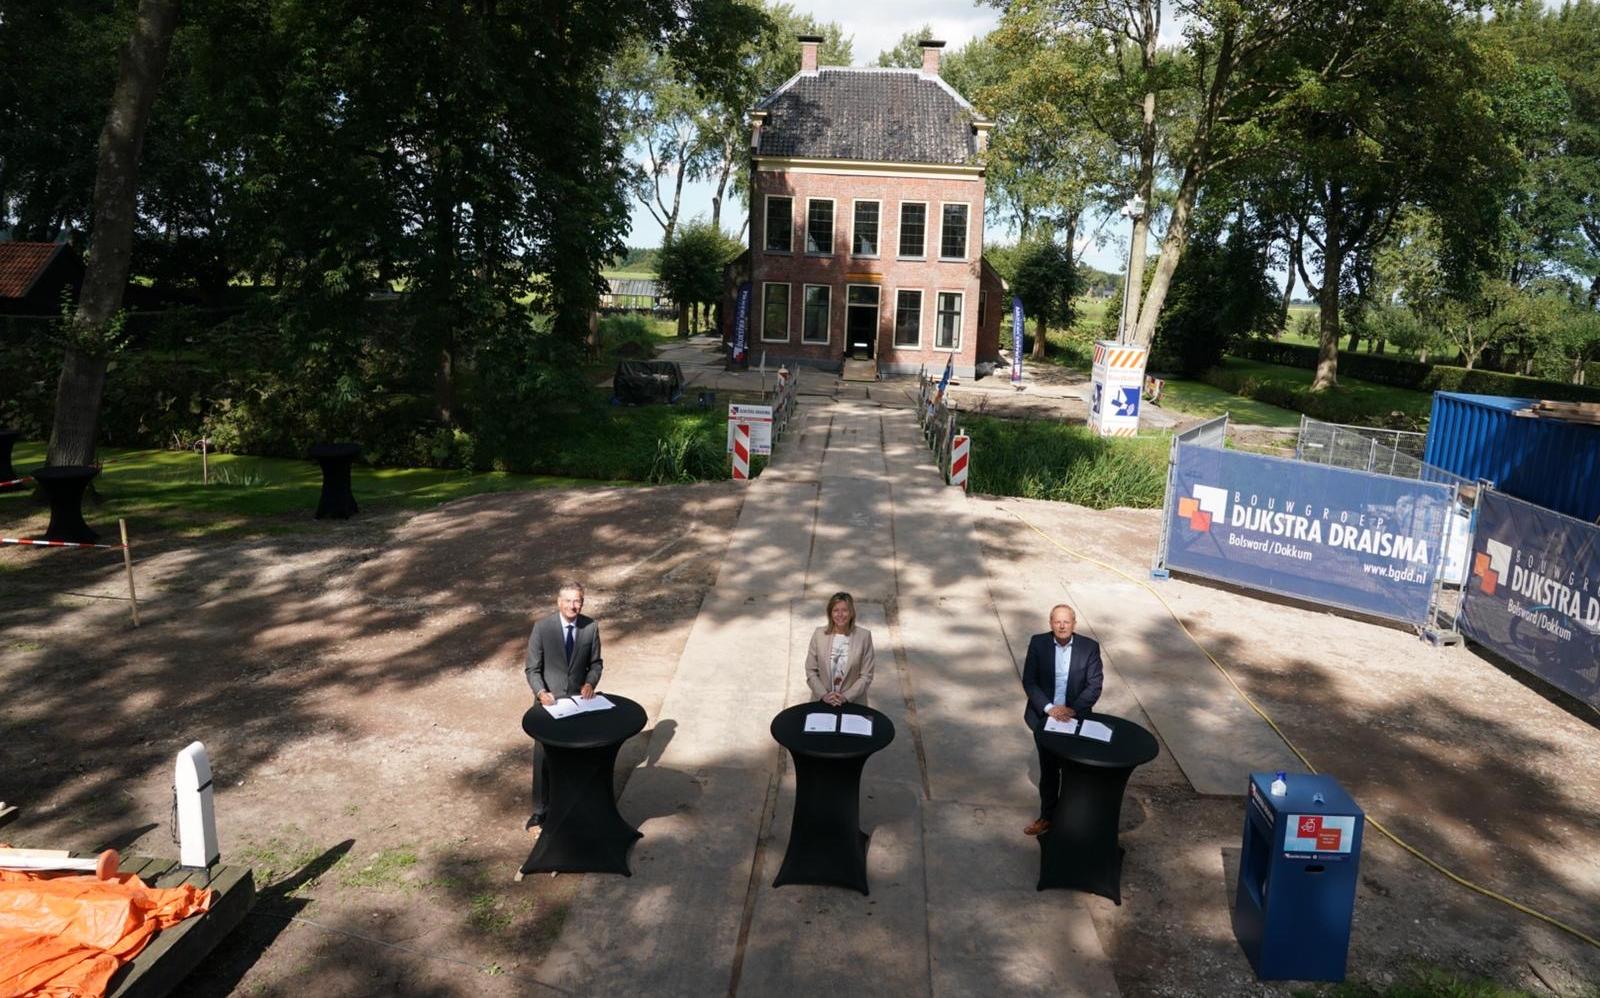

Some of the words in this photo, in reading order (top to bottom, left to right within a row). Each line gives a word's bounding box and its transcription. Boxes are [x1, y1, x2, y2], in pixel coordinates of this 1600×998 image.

[1231, 504, 1322, 543] DIJKSTRA
[1328, 523, 1429, 564] DRAISMA
[1363, 563, 1427, 585] www.bgdd.nl
[1511, 565, 1581, 620] DIJKSTRA
